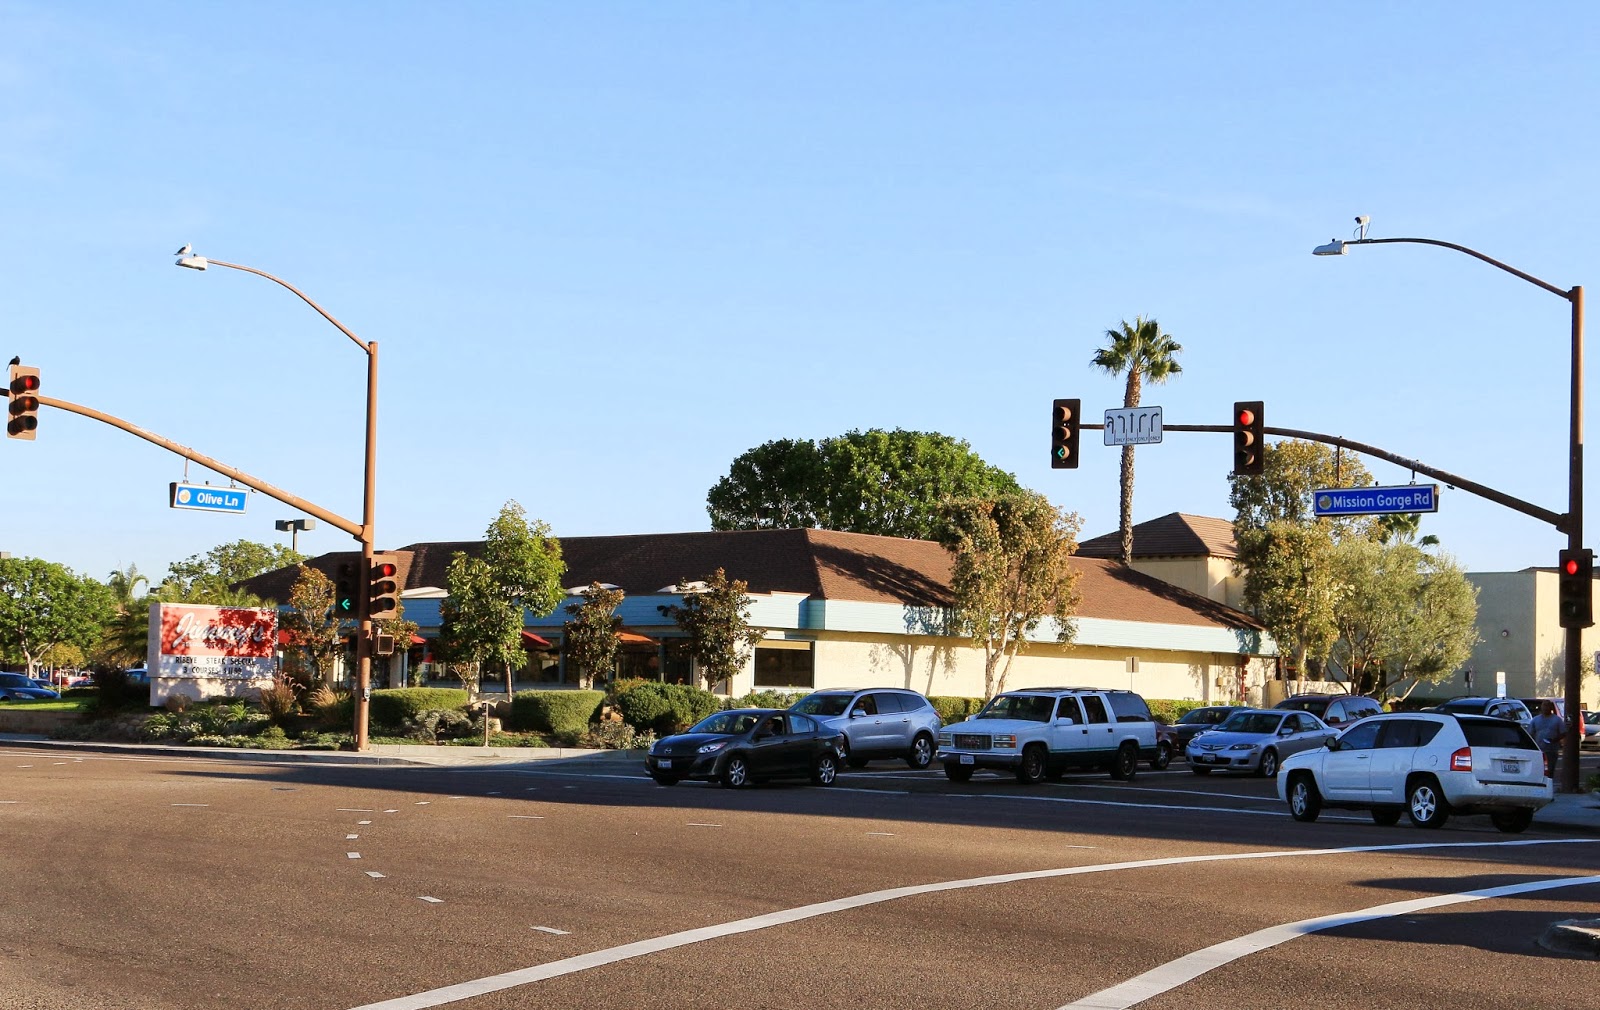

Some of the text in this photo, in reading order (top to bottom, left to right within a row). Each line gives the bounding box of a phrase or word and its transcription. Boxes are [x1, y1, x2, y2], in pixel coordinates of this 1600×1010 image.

[197, 492, 239, 507] Olive Ln
[1333, 493, 1430, 509] Mission Gorge Rd
[172, 612, 264, 649] Jimmy's
[175, 656, 255, 666] RIBEYE STEAK SPECIAL
[183, 666, 188, 674] 3
[191, 666, 219, 675] COURSES
